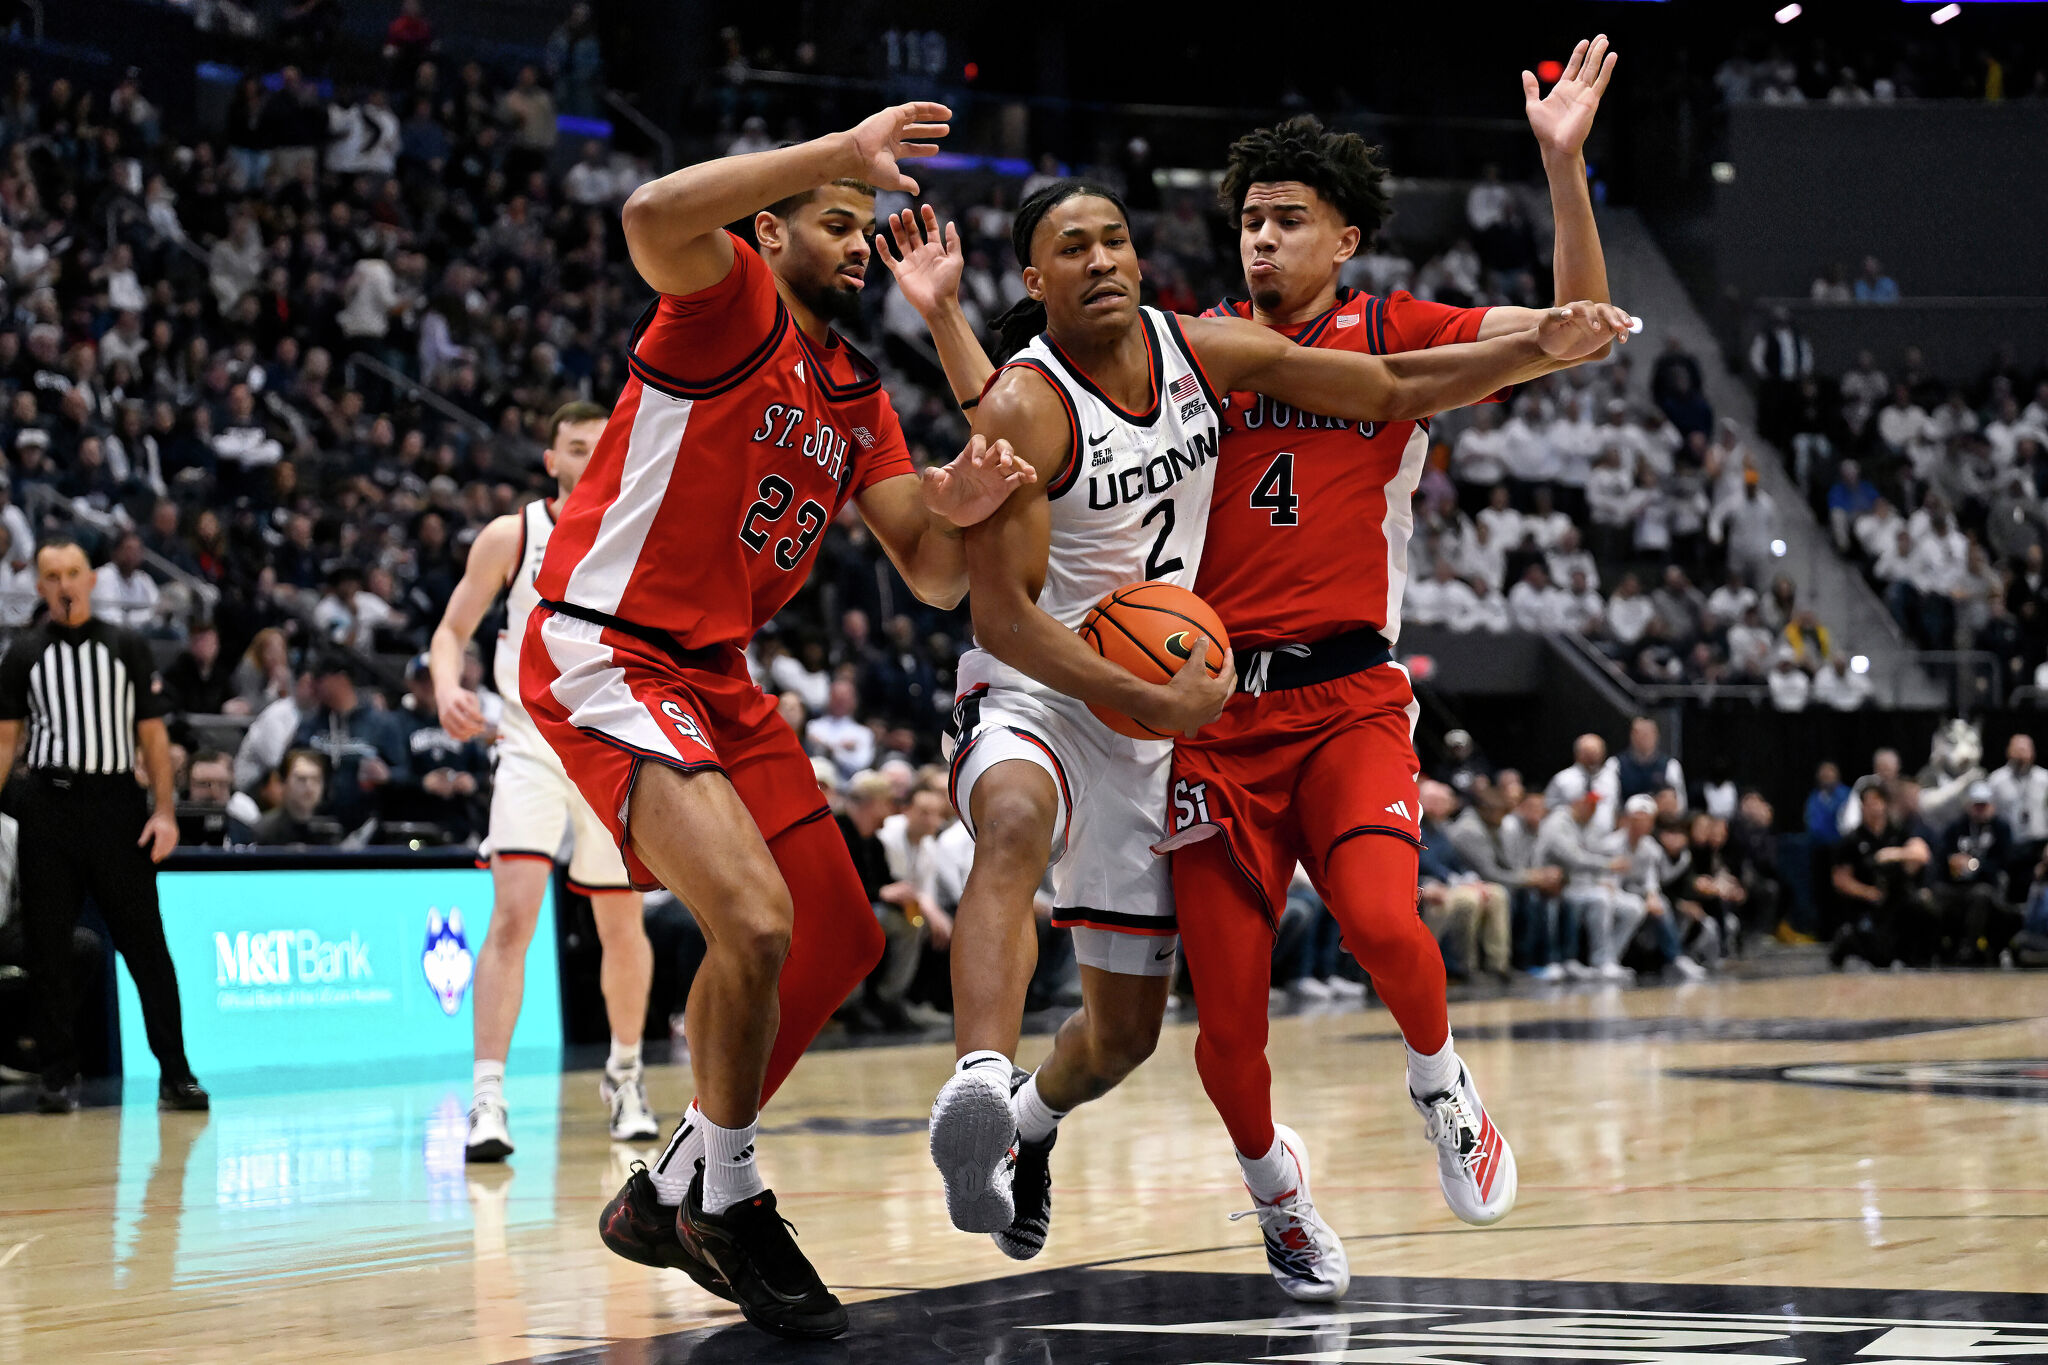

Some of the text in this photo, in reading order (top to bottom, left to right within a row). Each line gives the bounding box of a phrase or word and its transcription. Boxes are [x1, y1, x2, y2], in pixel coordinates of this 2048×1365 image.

[1181, 397, 1199, 413] BIG
[1181, 403, 1207, 420] EAST
[753, 404, 848, 481] ST. JOH
[1089, 427, 1219, 511] UCONN
[1091, 454, 1114, 467] CHANG
[1093, 446, 1112, 459] BE TH
[1250, 453, 1298, 526] 4
[739, 474, 828, 572] 23
[1141, 499, 1184, 581] 2
[213, 928, 374, 986] M&T Bank
